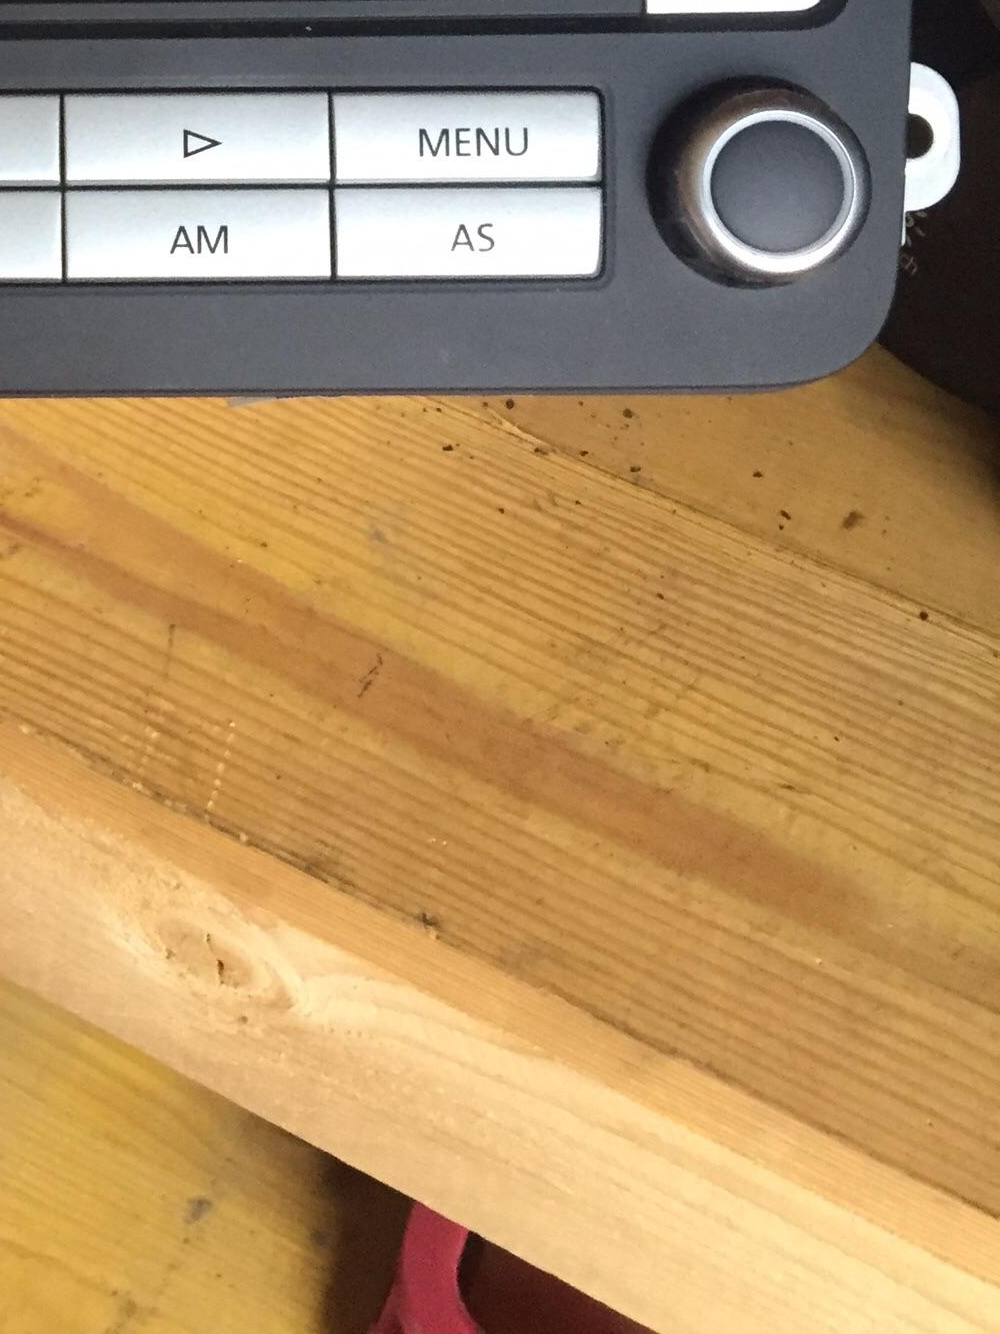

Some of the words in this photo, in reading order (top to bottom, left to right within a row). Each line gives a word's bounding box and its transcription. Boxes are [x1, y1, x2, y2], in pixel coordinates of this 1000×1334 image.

[417, 126, 530, 158] MENU
[169, 224, 230, 255] AM
[450, 223, 497, 253] AS
